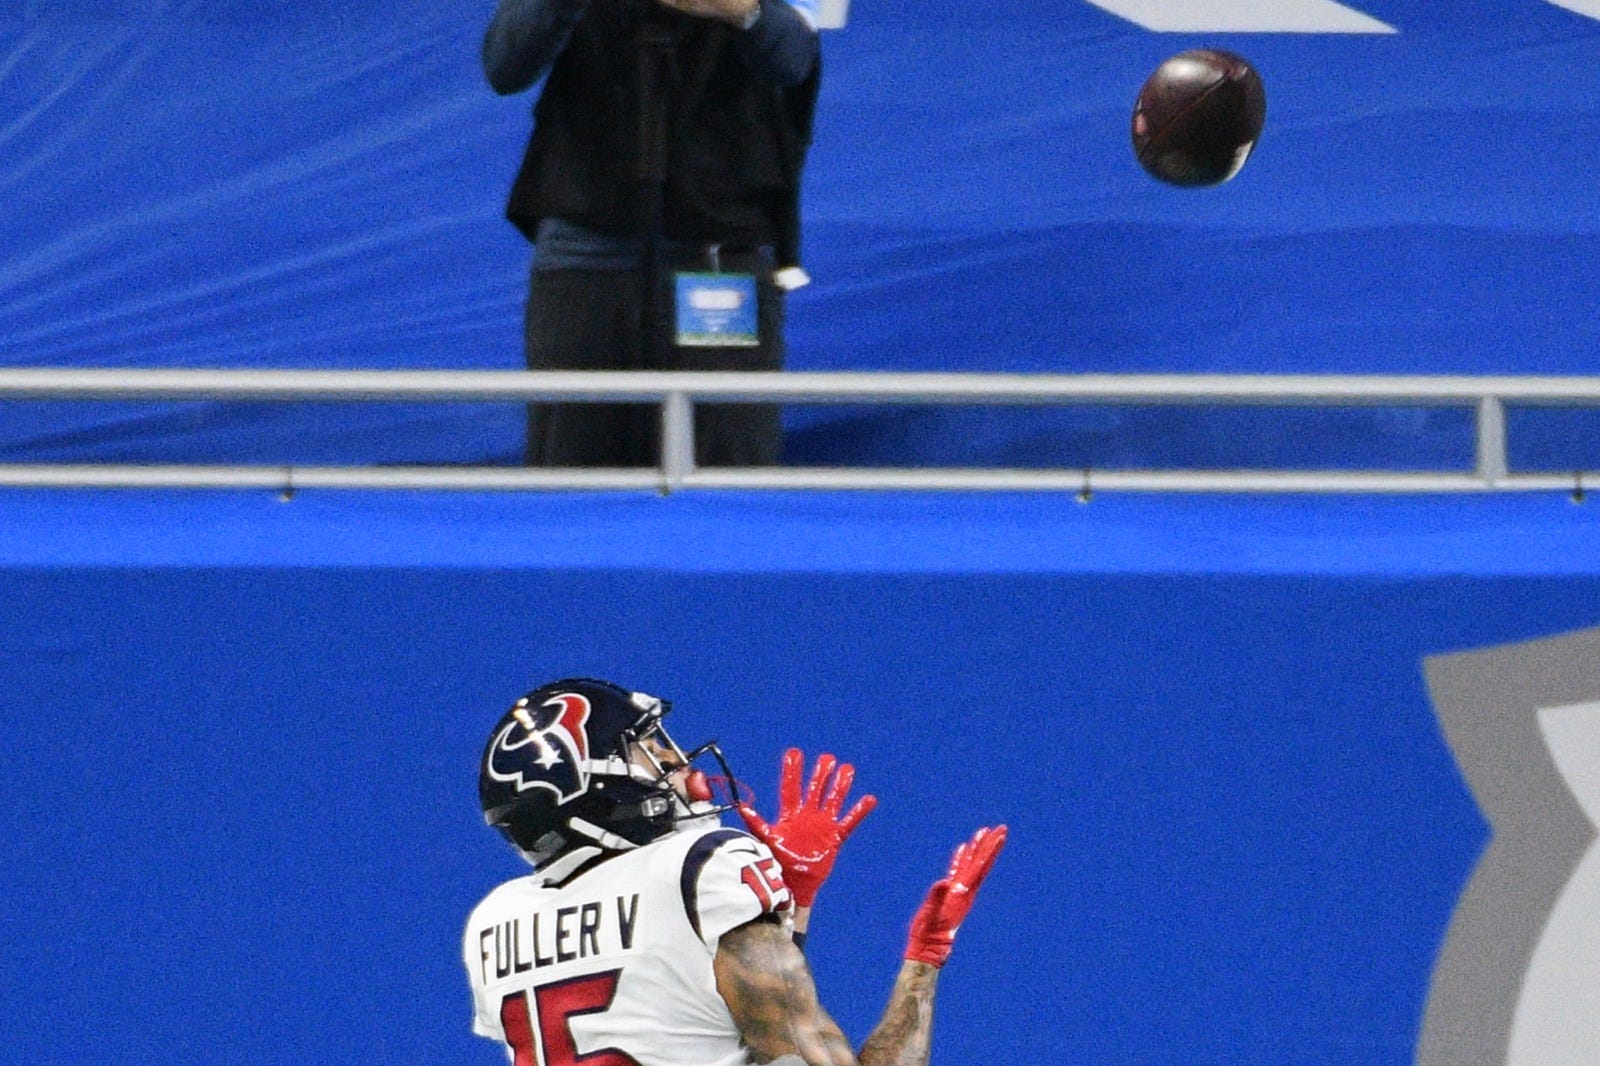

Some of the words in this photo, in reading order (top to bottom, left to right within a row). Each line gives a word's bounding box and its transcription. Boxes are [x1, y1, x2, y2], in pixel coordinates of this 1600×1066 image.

[741, 857, 792, 914] 15
[480, 901, 602, 986] FULLER
[617, 893, 640, 950] V
